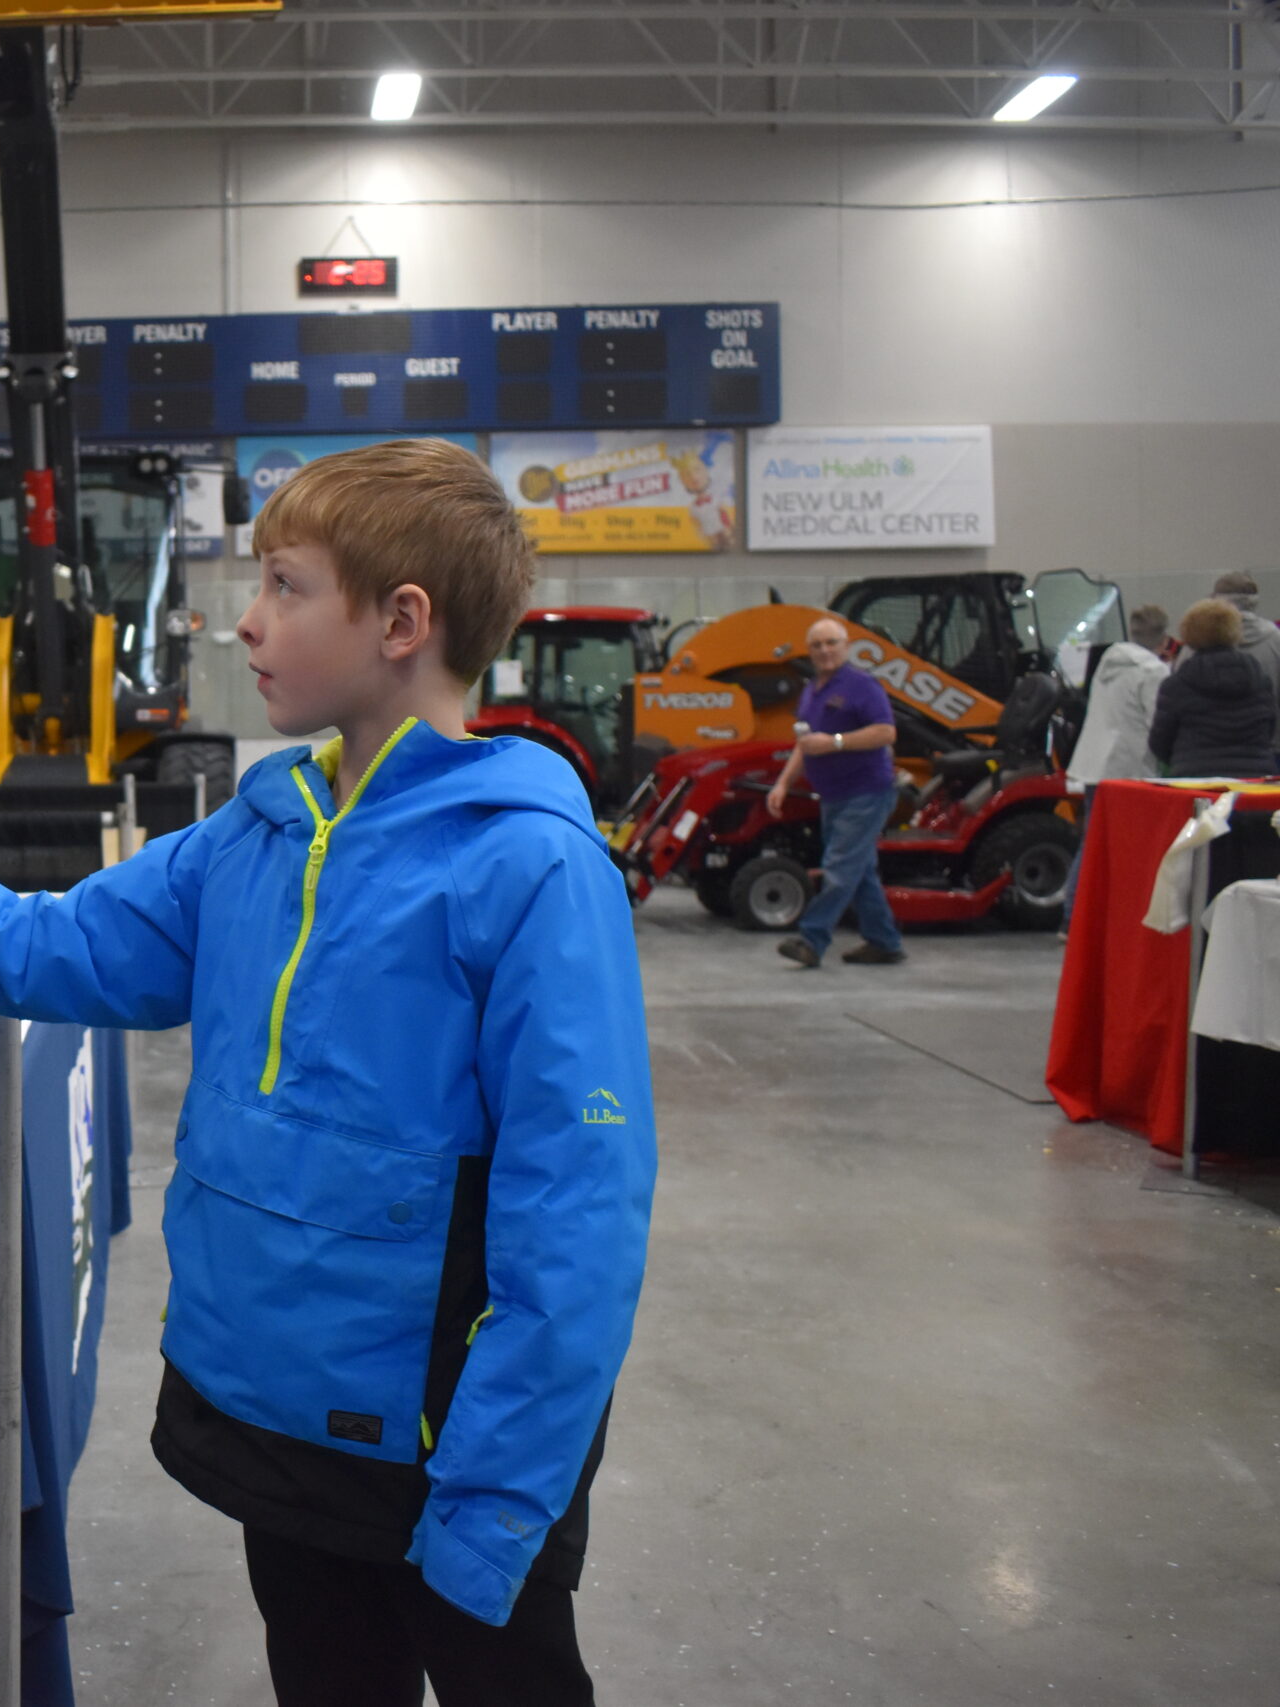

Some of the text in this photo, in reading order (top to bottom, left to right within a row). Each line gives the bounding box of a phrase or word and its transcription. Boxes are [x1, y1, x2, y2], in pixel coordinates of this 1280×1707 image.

[491, 311, 559, 332] PLAYER
[584, 309, 660, 329] PENALTY
[704, 308, 763, 329] SHOTS
[133, 323, 208, 342] PENALTY
[721, 329, 747, 348] ON
[404, 357, 461, 377] GUEST
[710, 349, 758, 369] GOAL
[250, 361, 300, 380] HOME
[762, 490, 884, 513] NEW ULM
[762, 513, 980, 536] MEDICAL CENTER
[847, 638, 976, 721] CASE
